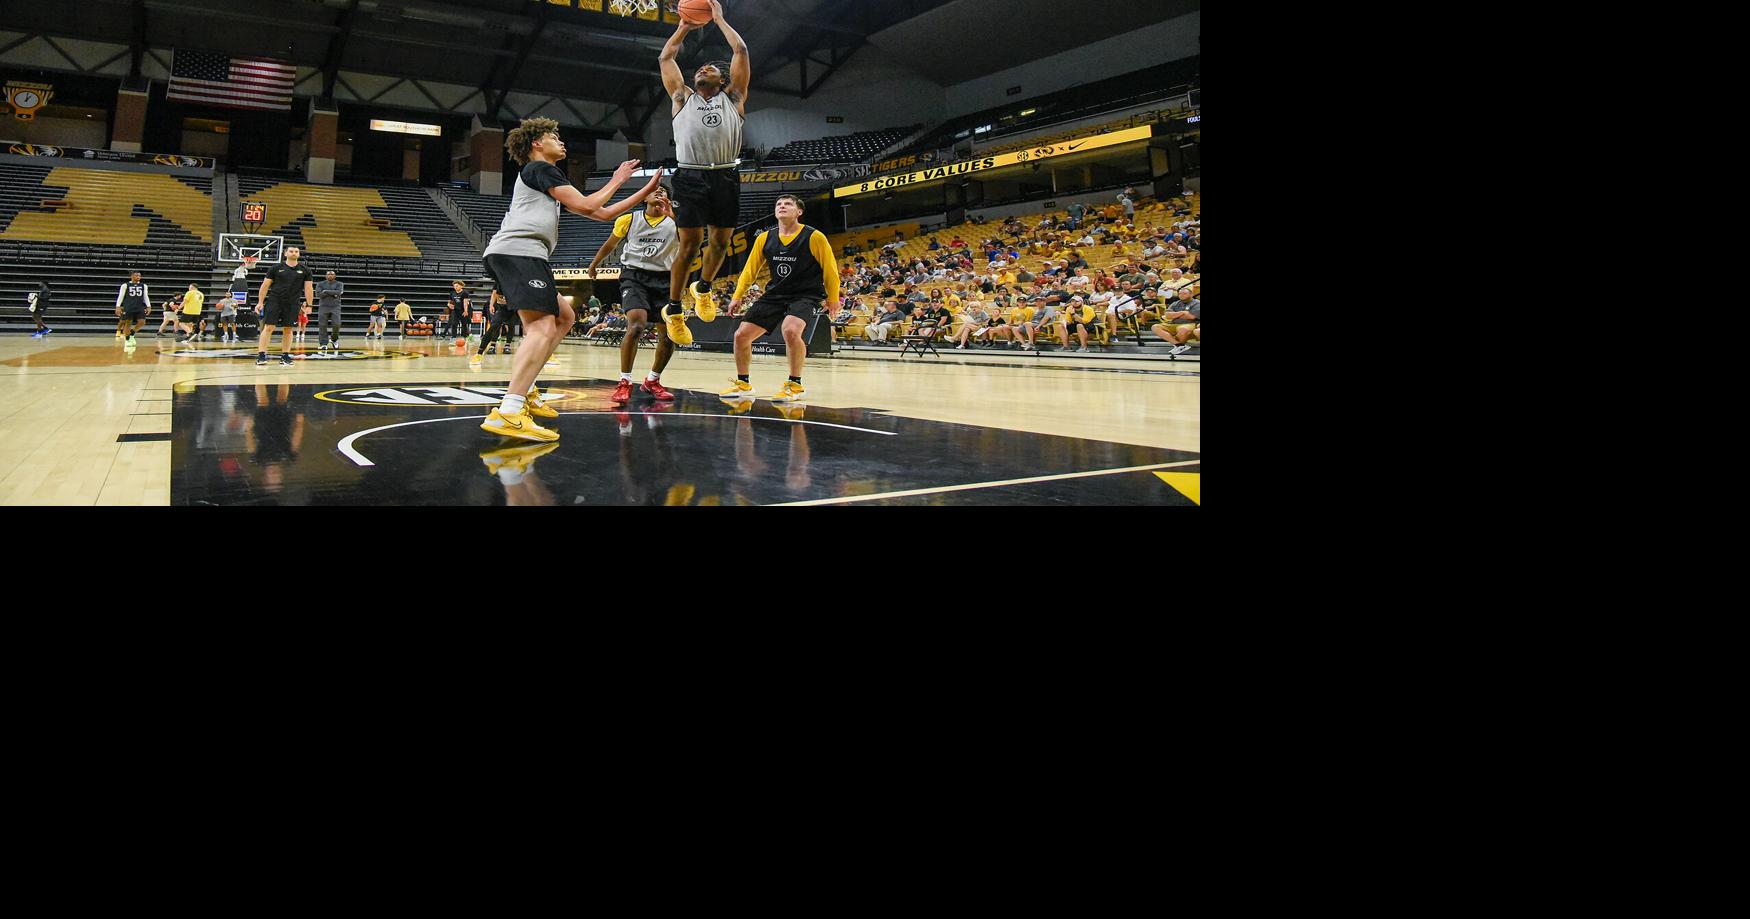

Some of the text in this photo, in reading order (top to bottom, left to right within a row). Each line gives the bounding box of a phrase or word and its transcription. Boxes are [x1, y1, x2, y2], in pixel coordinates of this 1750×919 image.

[706, 115, 718, 124] 23
[871, 155, 916, 173] TIGERS
[740, 170, 800, 183] MIZZOU
[860, 157, 995, 192] 8 CORE VALUES
[245, 210, 260, 220] 20
[780, 266, 788, 275] 13
[128, 286, 143, 297] 55
